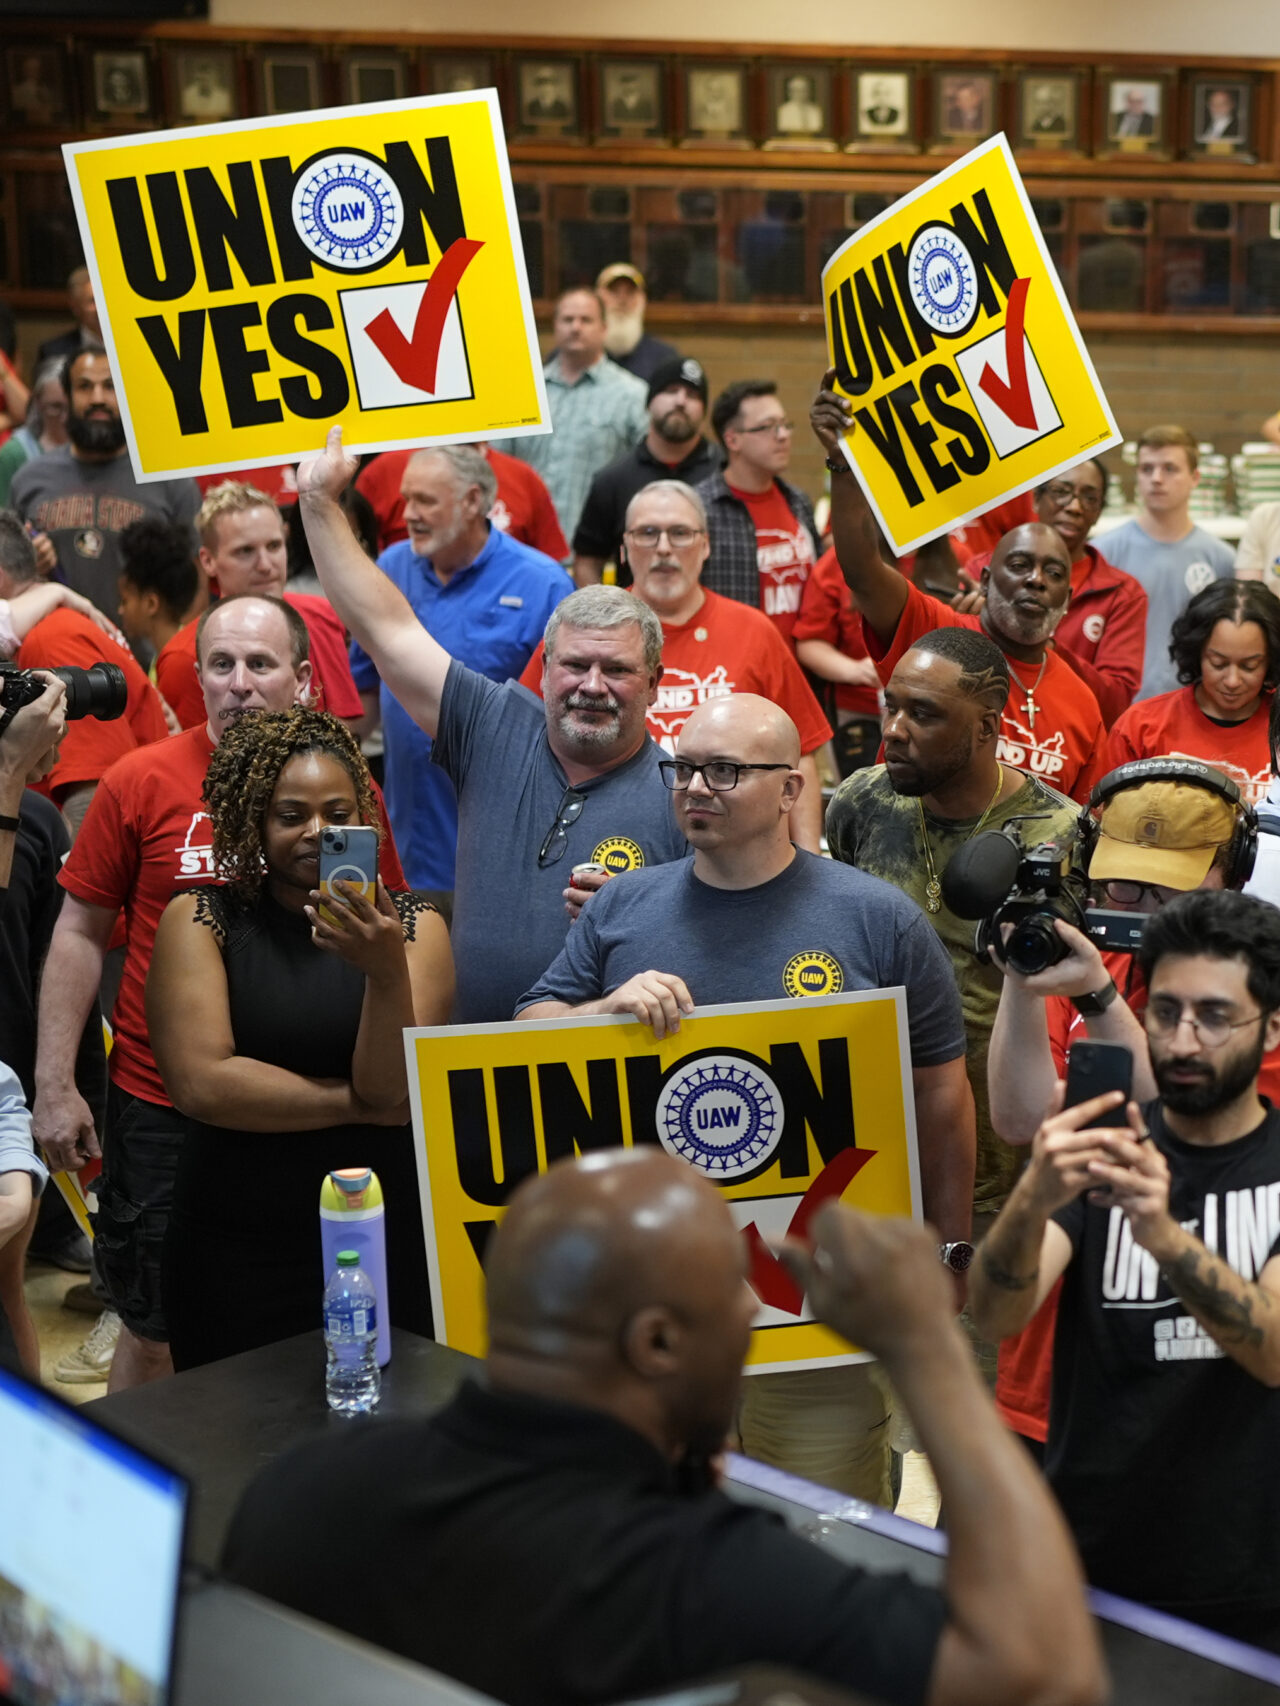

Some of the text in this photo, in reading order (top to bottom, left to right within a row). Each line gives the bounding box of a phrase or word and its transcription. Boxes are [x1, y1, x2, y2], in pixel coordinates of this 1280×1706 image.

[106, 136, 466, 301] UNION
[327, 201, 366, 224] UAW
[830, 188, 1018, 396] UNION
[929, 267, 953, 293] UAW
[136, 293, 349, 435] YES
[854, 363, 990, 508] YES
[1029, 747, 1064, 774] UP
[606, 855, 628, 868] UAW
[1032, 868, 1050, 876] JVC
[800, 971, 823, 985] UAW
[696, 1106, 741, 1130] UAW
